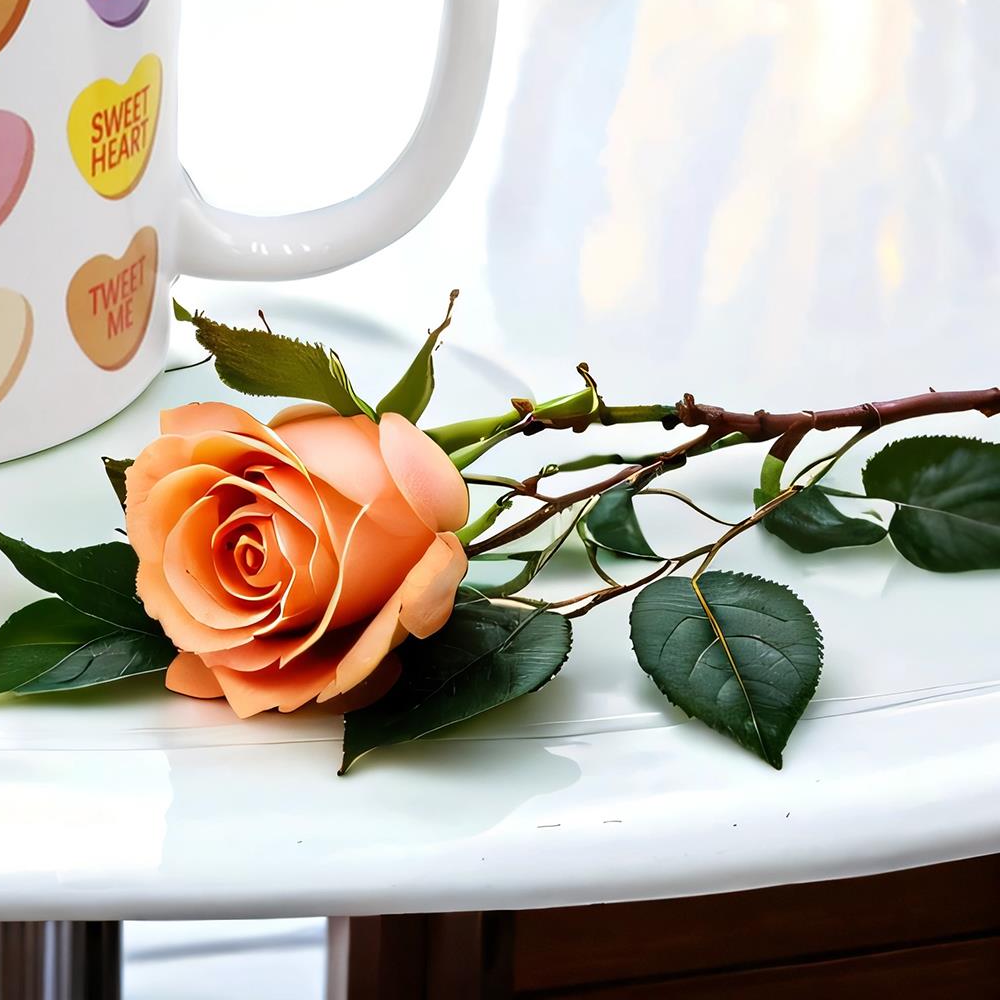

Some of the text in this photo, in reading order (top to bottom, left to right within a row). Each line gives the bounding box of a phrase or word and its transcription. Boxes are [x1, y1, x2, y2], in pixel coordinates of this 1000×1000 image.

[91, 84, 150, 143] SWEET
[91, 118, 149, 177] HEART
[88, 256, 146, 316] TWEET
[107, 297, 133, 339] ME
